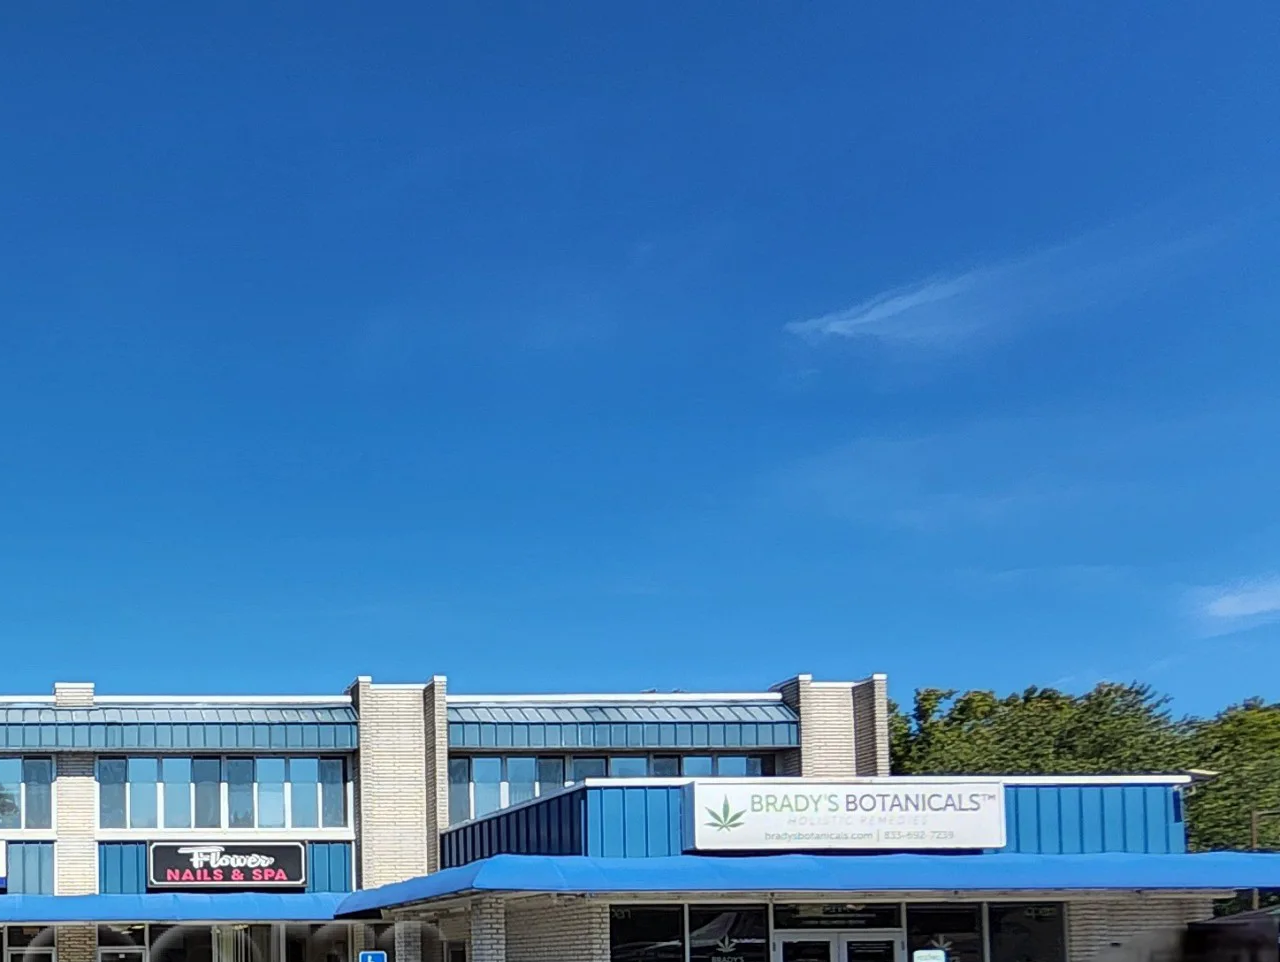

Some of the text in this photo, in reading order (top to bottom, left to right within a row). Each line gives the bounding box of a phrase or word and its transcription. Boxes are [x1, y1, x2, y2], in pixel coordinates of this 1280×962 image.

[751, 794, 840, 812] BRADY'S
[177, 846, 275, 869] Flower
[166, 869, 288, 881] NAILS & SPA
